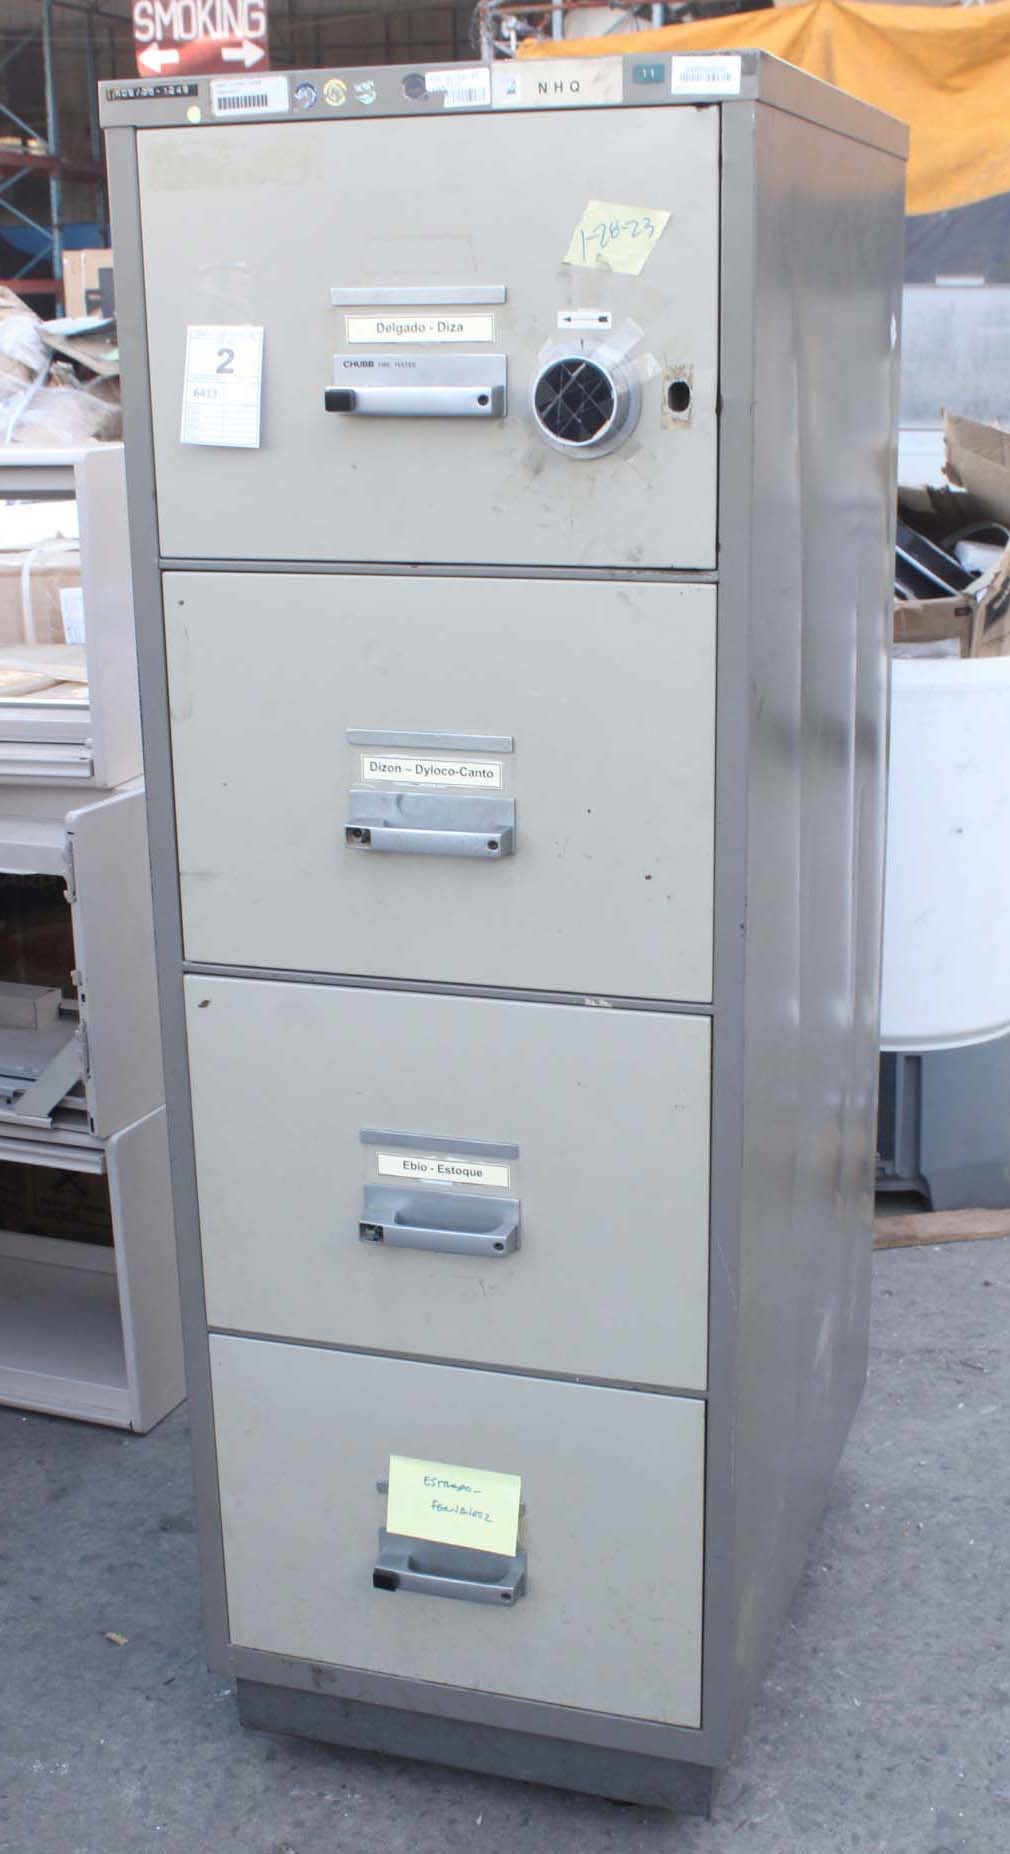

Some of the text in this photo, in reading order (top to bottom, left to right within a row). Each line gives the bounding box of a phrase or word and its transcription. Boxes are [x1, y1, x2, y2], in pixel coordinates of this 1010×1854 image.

[133, 0, 267, 42] SMOKING
[376, 321, 426, 336] Delgado
[437, 321, 464, 333] Diza
[215, 347, 235, 375] 2
[343, 360, 375, 369] CHUBB
[369, 761, 402, 774] Dizon
[415, 764, 494, 779] Dyloco-Canto
[402, 1160, 428, 1172] Ebio
[437, 1164, 483, 1179] Estoque
